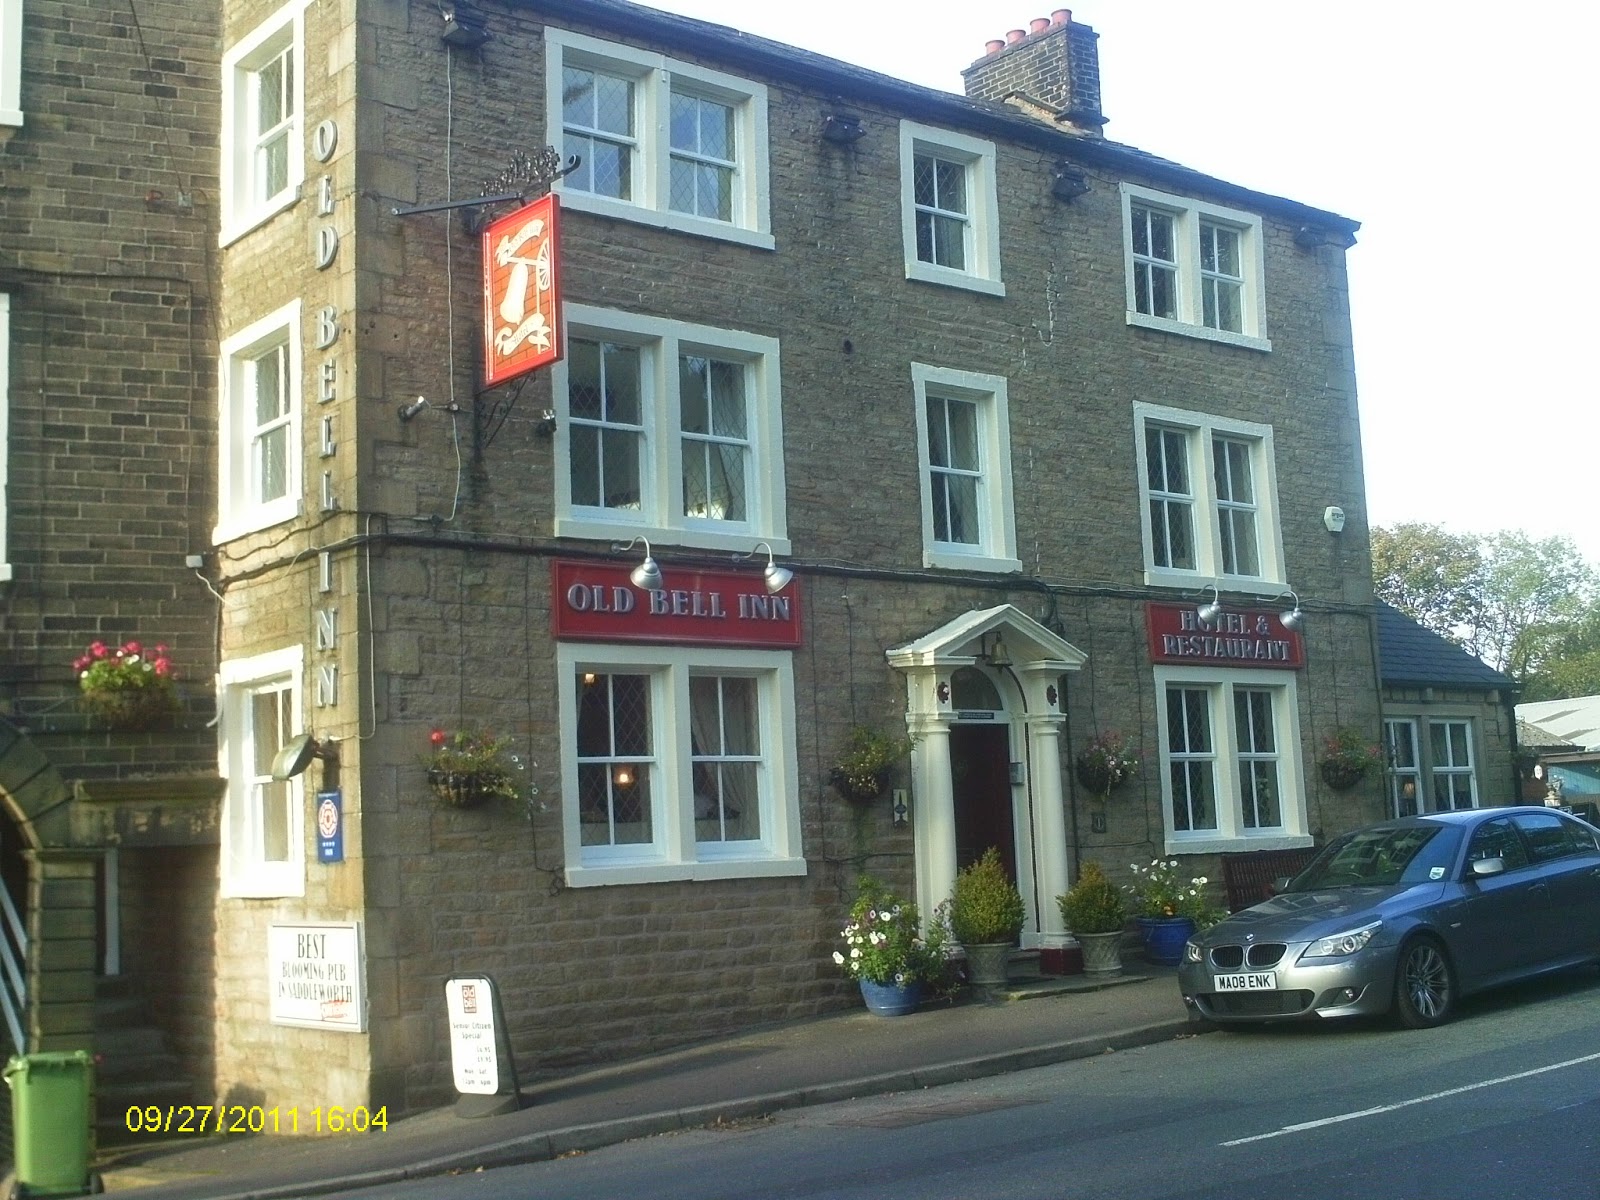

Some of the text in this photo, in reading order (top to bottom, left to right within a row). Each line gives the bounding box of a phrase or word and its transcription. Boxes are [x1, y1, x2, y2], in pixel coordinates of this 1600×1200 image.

[313, 119, 339, 708] OLD BELL INN
[567, 583, 790, 621] OLD BELL INN
[1179, 610, 1270, 636] HOTEL &
[1162, 633, 1290, 661] RESTAURANT
[297, 933, 326, 959] BEST
[282, 961, 346, 981] BLOOMING PUB
[1219, 974, 1271, 989] MA08 ENK
[288, 982, 353, 1003] SADDLEWORTH
